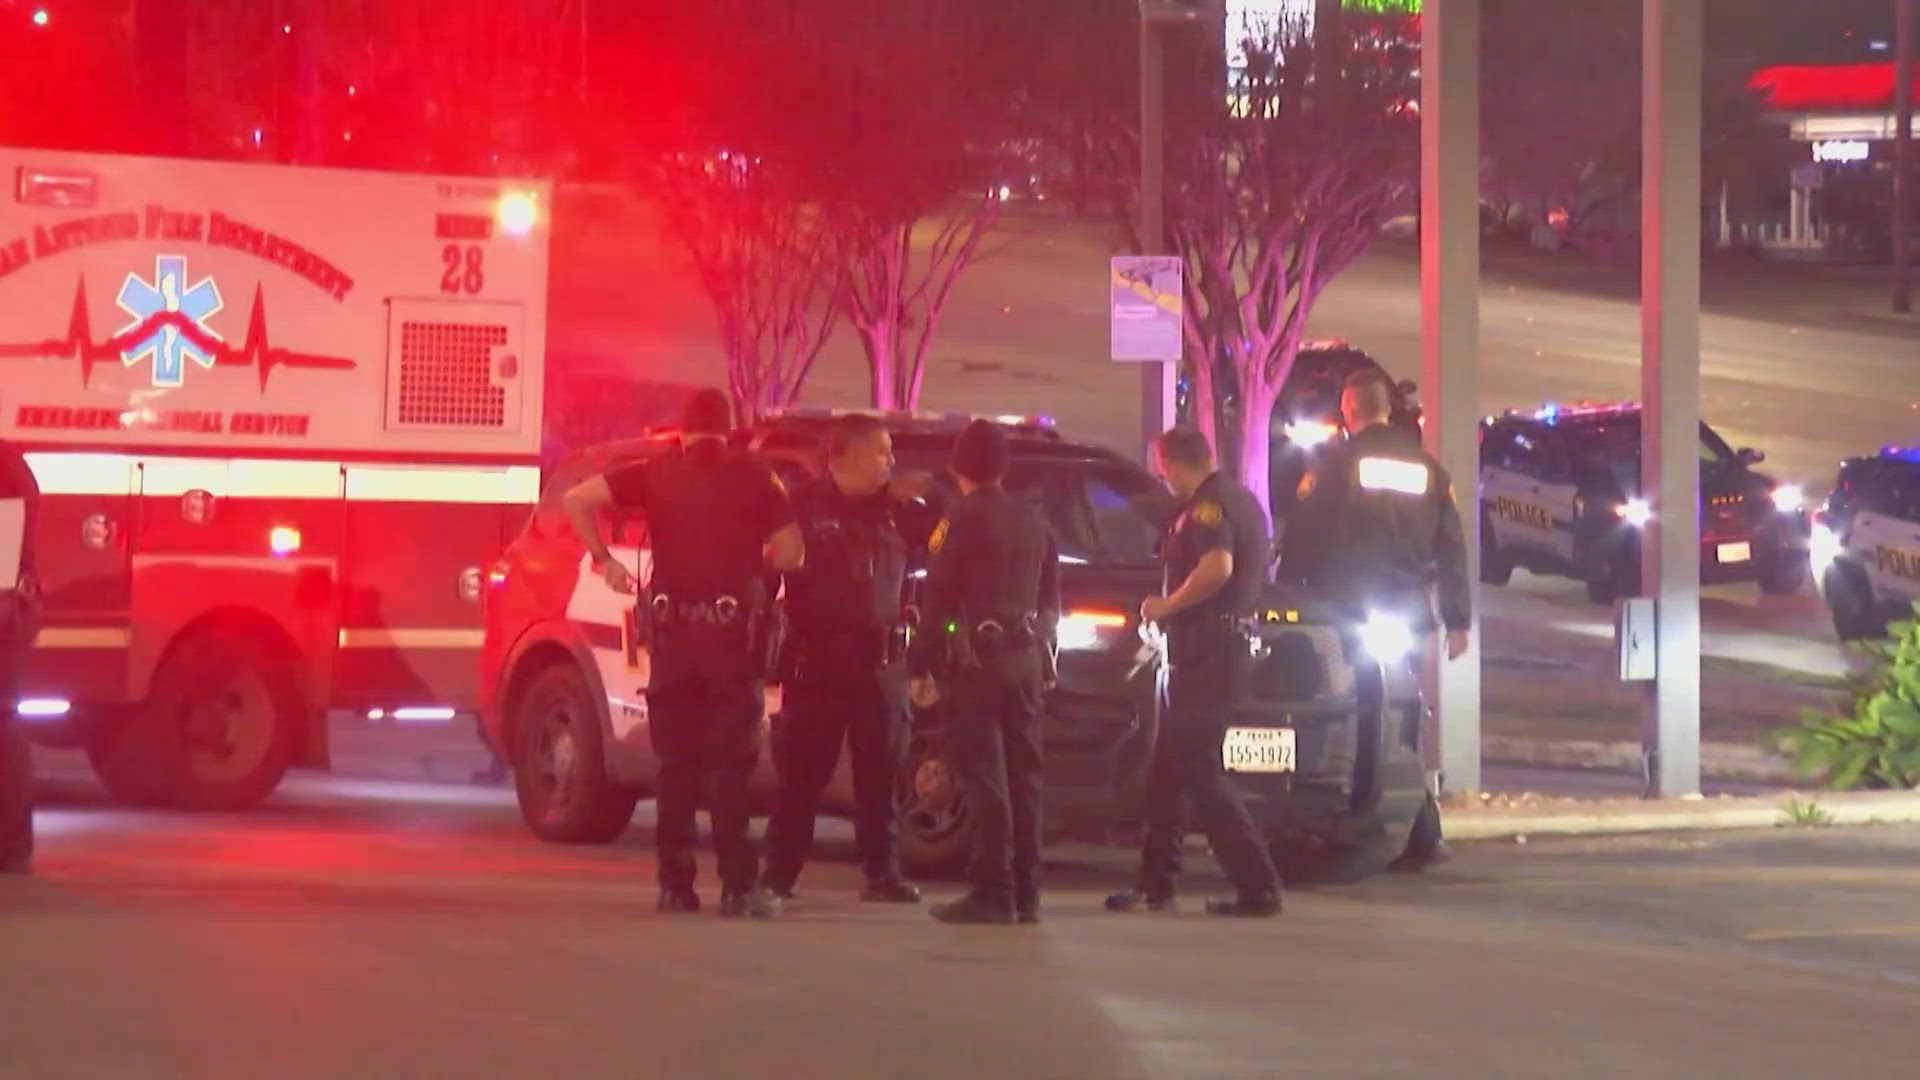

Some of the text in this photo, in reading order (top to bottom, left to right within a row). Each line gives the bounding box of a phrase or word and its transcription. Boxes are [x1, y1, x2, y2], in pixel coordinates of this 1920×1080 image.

[145, 204, 203, 242] FIRE
[207, 211, 354, 304] DEPARTMENT
[440, 244, 484, 296] 28
[1497, 496, 1552, 532] POLICE
[1876, 545, 1920, 580] POLI
